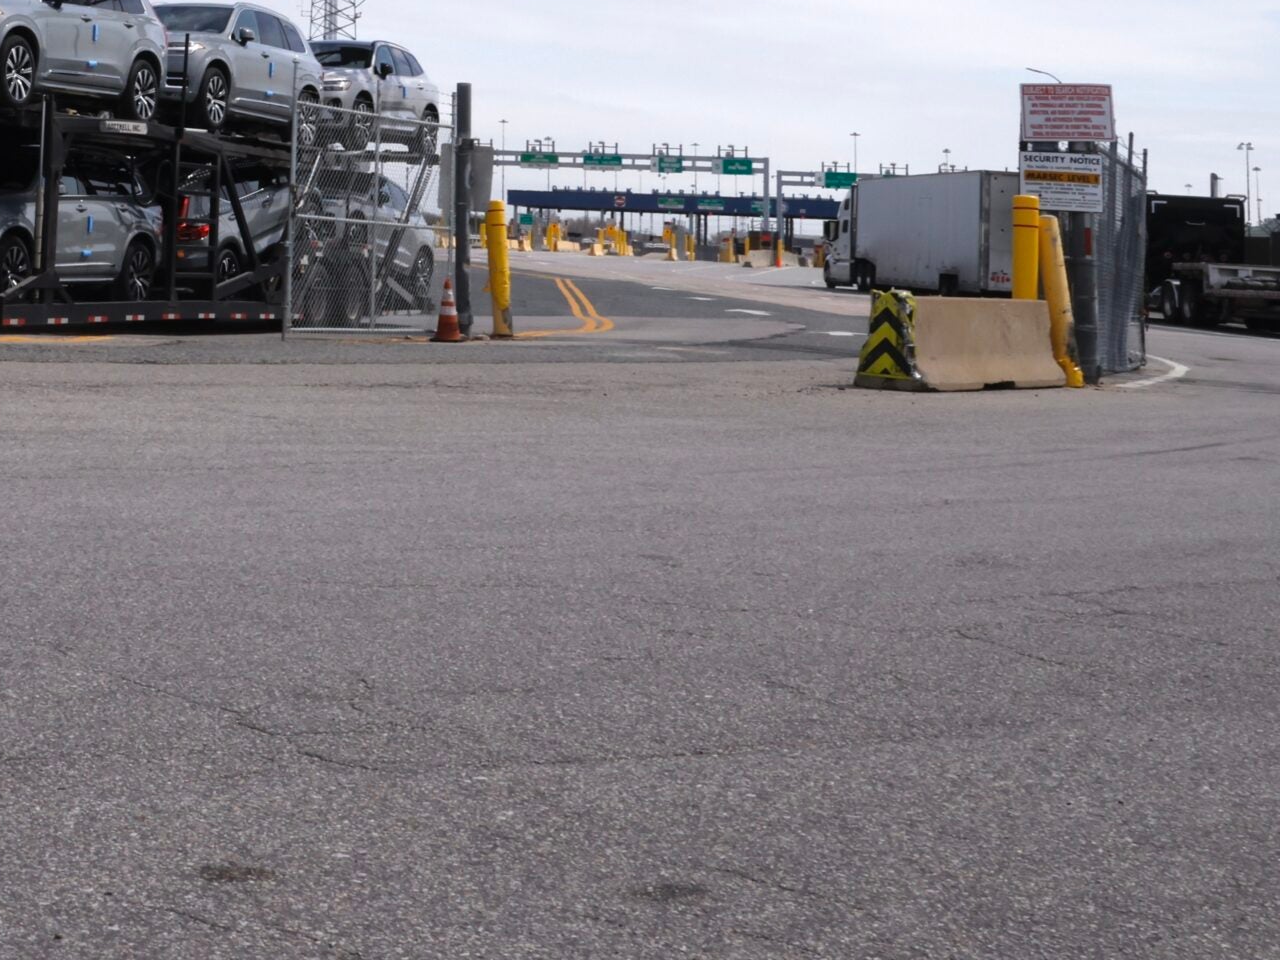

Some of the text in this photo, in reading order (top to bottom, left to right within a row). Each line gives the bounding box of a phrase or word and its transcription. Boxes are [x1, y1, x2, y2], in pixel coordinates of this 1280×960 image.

[1023, 155, 1100, 165] SECURITY NOTICE
[1067, 174, 1090, 183] LEVEL
